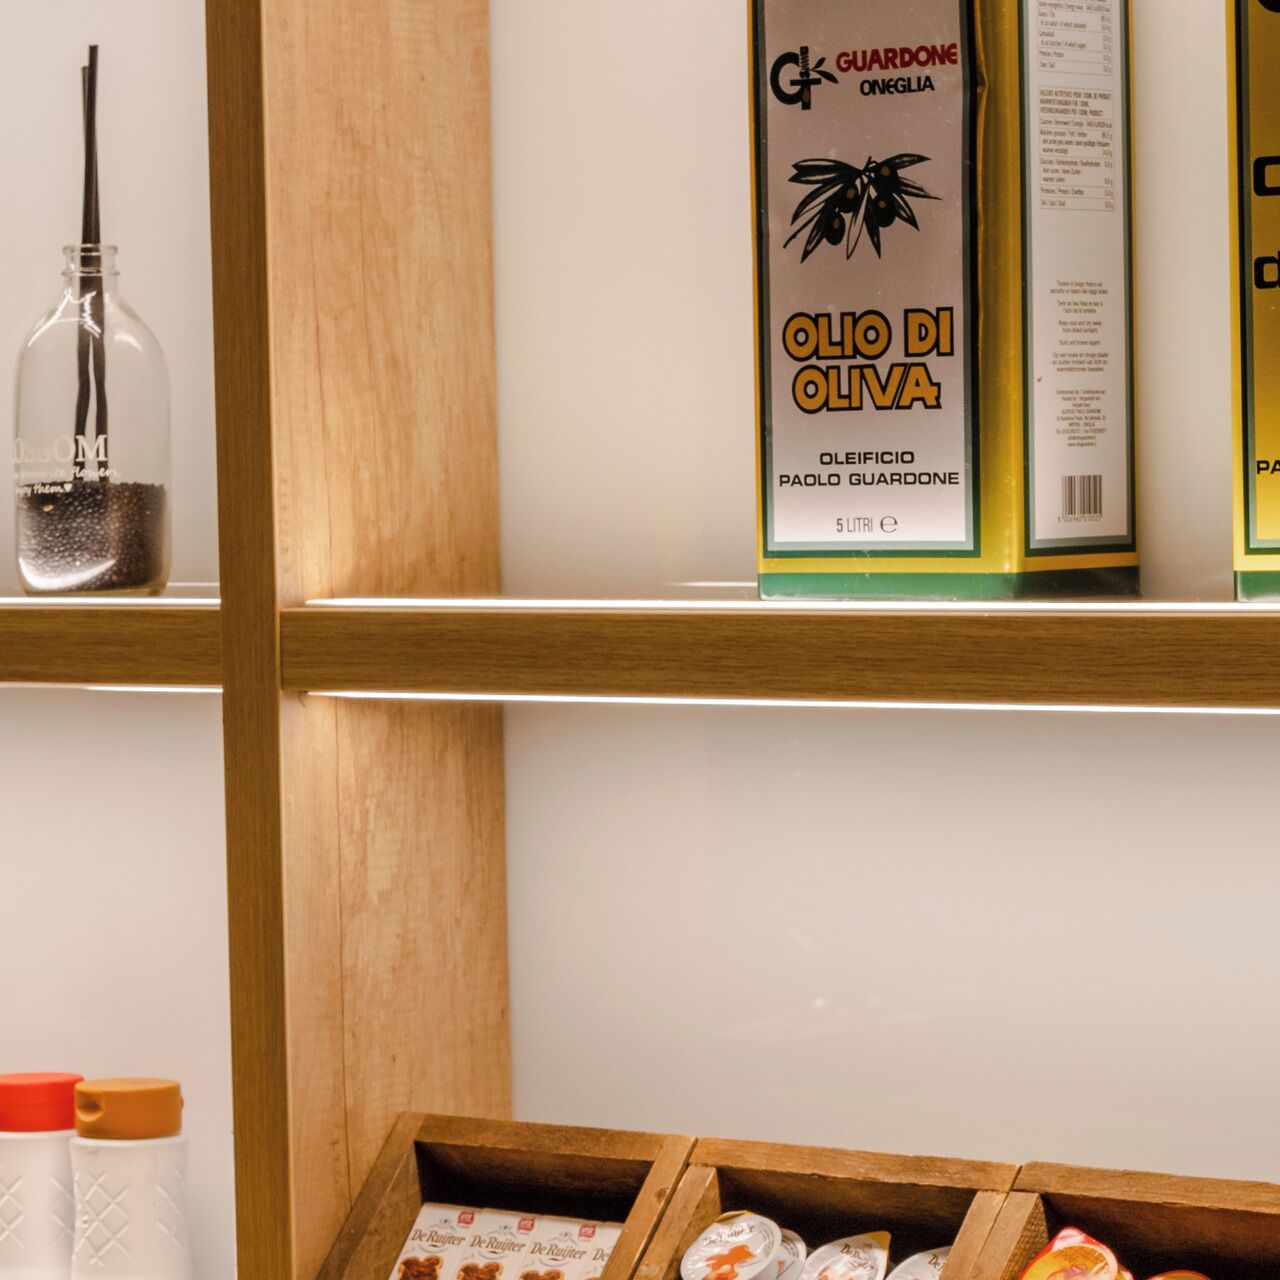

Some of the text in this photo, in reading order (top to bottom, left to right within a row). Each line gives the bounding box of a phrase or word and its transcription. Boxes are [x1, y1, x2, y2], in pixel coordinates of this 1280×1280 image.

[836, 43, 958, 72] GUARDONE
[860, 77, 935, 96] ONEGLIA
[783, 306, 954, 362] OLIO DI
[792, 362, 942, 414] OLIVA
[820, 451, 914, 465] OLEIFICIO
[780, 472, 959, 487] PAOLO GUARDONE
[836, 518, 843, 532] 5
[847, 517, 873, 533] LITRI
[411, 1229, 466, 1246] De Ruijter
[470, 1235, 526, 1252] De Ruijter
[530, 1242, 587, 1260] De Ruijter
[592, 1248, 609, 1261] De
